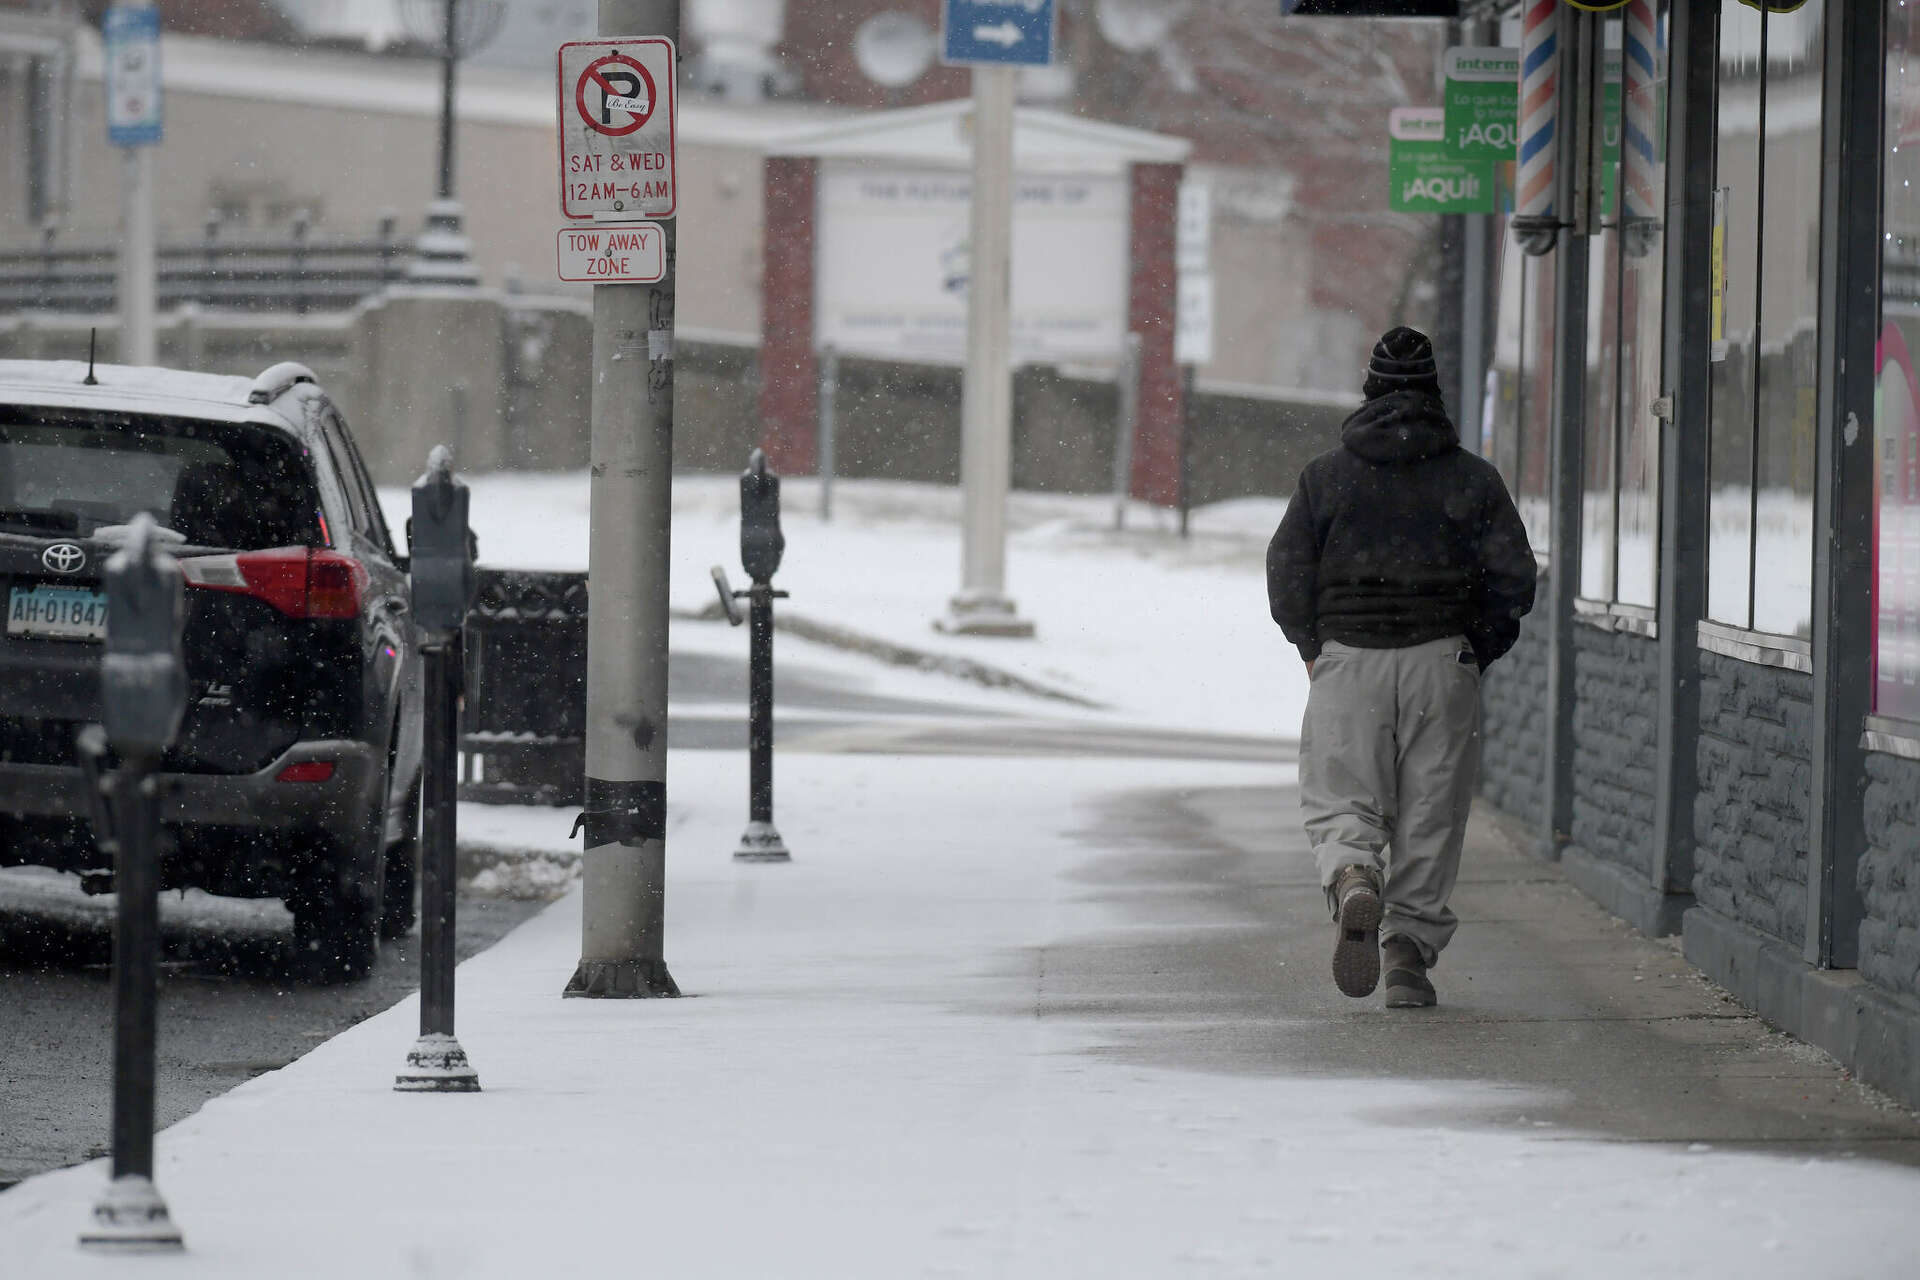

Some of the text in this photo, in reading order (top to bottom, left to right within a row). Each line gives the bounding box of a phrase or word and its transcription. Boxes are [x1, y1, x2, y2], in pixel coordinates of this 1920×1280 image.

[570, 152, 665, 173] SAT & WED
[568, 233, 649, 252] TOW AWAY
[587, 256, 631, 275] ZONE
[207, 683, 233, 695] LE
